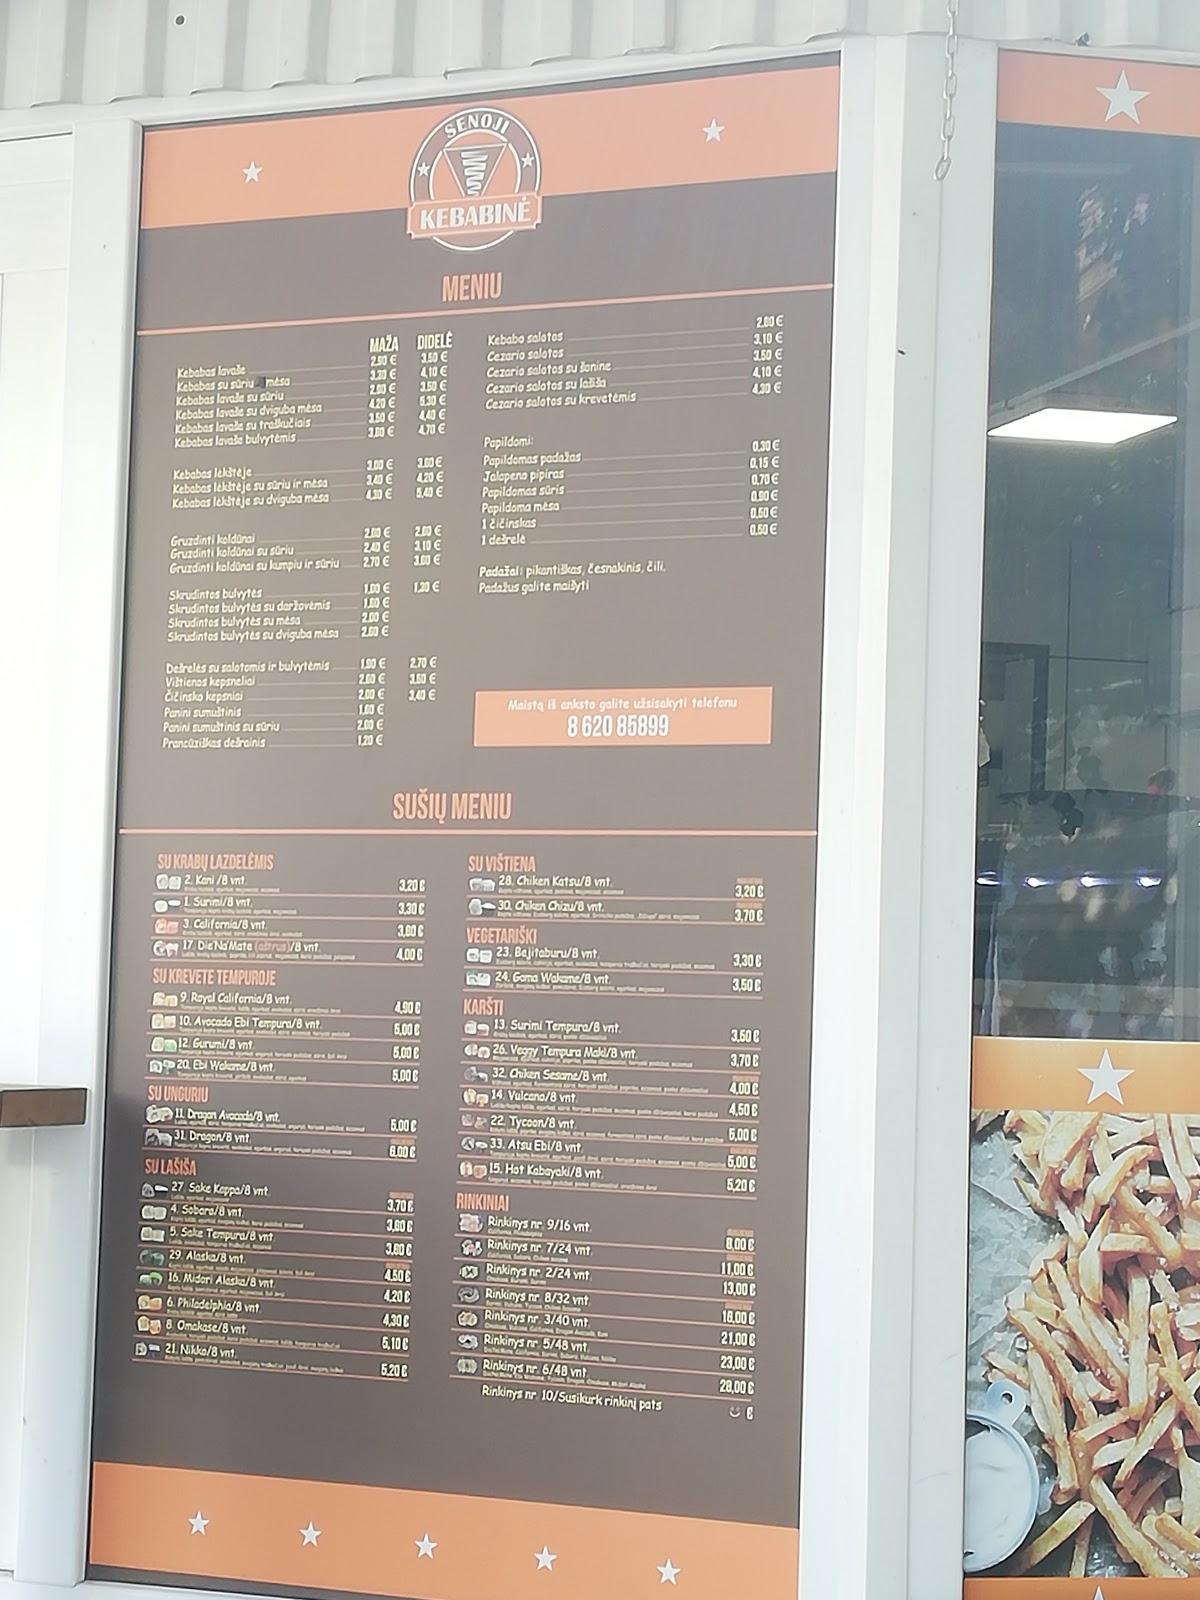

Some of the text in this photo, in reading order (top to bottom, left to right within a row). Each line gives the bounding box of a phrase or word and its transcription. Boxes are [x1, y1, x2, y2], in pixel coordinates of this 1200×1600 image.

[444, 113, 510, 139] SENOJI
[420, 195, 531, 230] KEBABINĖ
[442, 272, 502, 302] MENIU
[369, 335, 398, 352] MAŽA
[417, 331, 452, 350] DIDELĖ
[488, 331, 563, 346] Kebabo salotos
[775, 332, 783, 343] €
[487, 347, 564, 361] Cezario salotos
[177, 368, 216, 378] Kebabas
[440, 365, 447, 376] €
[487, 367, 524, 378] Cezario
[527, 364, 563, 376] salotos
[566, 364, 577, 373] su
[177, 382, 215, 392] Kebabas
[217, 382, 228, 390] su
[230, 379, 254, 389] sūriu
[486, 383, 523, 394] Cezario
[526, 380, 562, 392] salotos
[565, 380, 577, 389] su
[486, 398, 523, 410] Cezario
[526, 396, 562, 408] salotos
[565, 396, 576, 405] su
[176, 409, 214, 420] Kebabas
[247, 407, 258, 416] su
[260, 404, 295, 417] dviguba
[175, 423, 213, 434] Kebabas
[246, 421, 256, 430] su
[483, 452, 581, 468] Papildomas padažas
[772, 455, 780, 468] €
[174, 469, 211, 480] Kebabas
[483, 469, 564, 484] Jalapeno pipiras
[173, 483, 211, 494] Kebabas
[254, 481, 264, 490] su
[267, 479, 290, 489] sūriu
[293, 479, 301, 488] ir
[482, 502, 531, 516] Papildoma
[489, 517, 536, 529] čičinskas
[170, 562, 213, 574] Gruzdinti
[257, 563, 267, 572] su
[305, 559, 313, 569] ir
[479, 579, 590, 595] Padažus galite maišyti
[168, 603, 219, 614] Skrudintos
[264, 602, 275, 611] su
[208, 663, 220, 673] su
[221, 661, 266, 673] salotomis
[268, 662, 276, 671] ir
[165, 675, 255, 688] Vištienos kepsneliai
[206, 690, 243, 704] kepsniai
[508, 698, 544, 712] Maistą
[560, 700, 596, 710] anksto
[599, 699, 629, 712] galite
[634, 697, 687, 711] užsisakyti
[692, 697, 737, 709] telefonu
[164, 706, 241, 718] Panini sumuštinis
[567, 714, 669, 737] 8 620 85899
[393, 787, 512, 824] SUŠIŲ MENIU
[158, 852, 273, 872] SU KRABŲ LAZDELĖMIS
[469, 853, 535, 872] SU VIŠTIENA
[467, 925, 537, 944] VEGETARIŠKI
[153, 967, 276, 986] SU KREVETE TEMPUROJE
[464, 996, 503, 1015] KARŠTI
[148, 1085, 208, 1102] SU UNGURIU
[145, 1156, 196, 1176] SU LAŠIŠA
[506, 1163, 524, 1174] Hot
[456, 1193, 509, 1211] RINKINIAI
[488, 1215, 527, 1230] Rinkinys
[547, 1219, 570, 1232] 9/16
[485, 1288, 525, 1303] Rinkinys
[544, 1292, 569, 1304] 8/32
[482, 1385, 522, 1401] Rinkinys
[639, 1399, 662, 1412] pats
